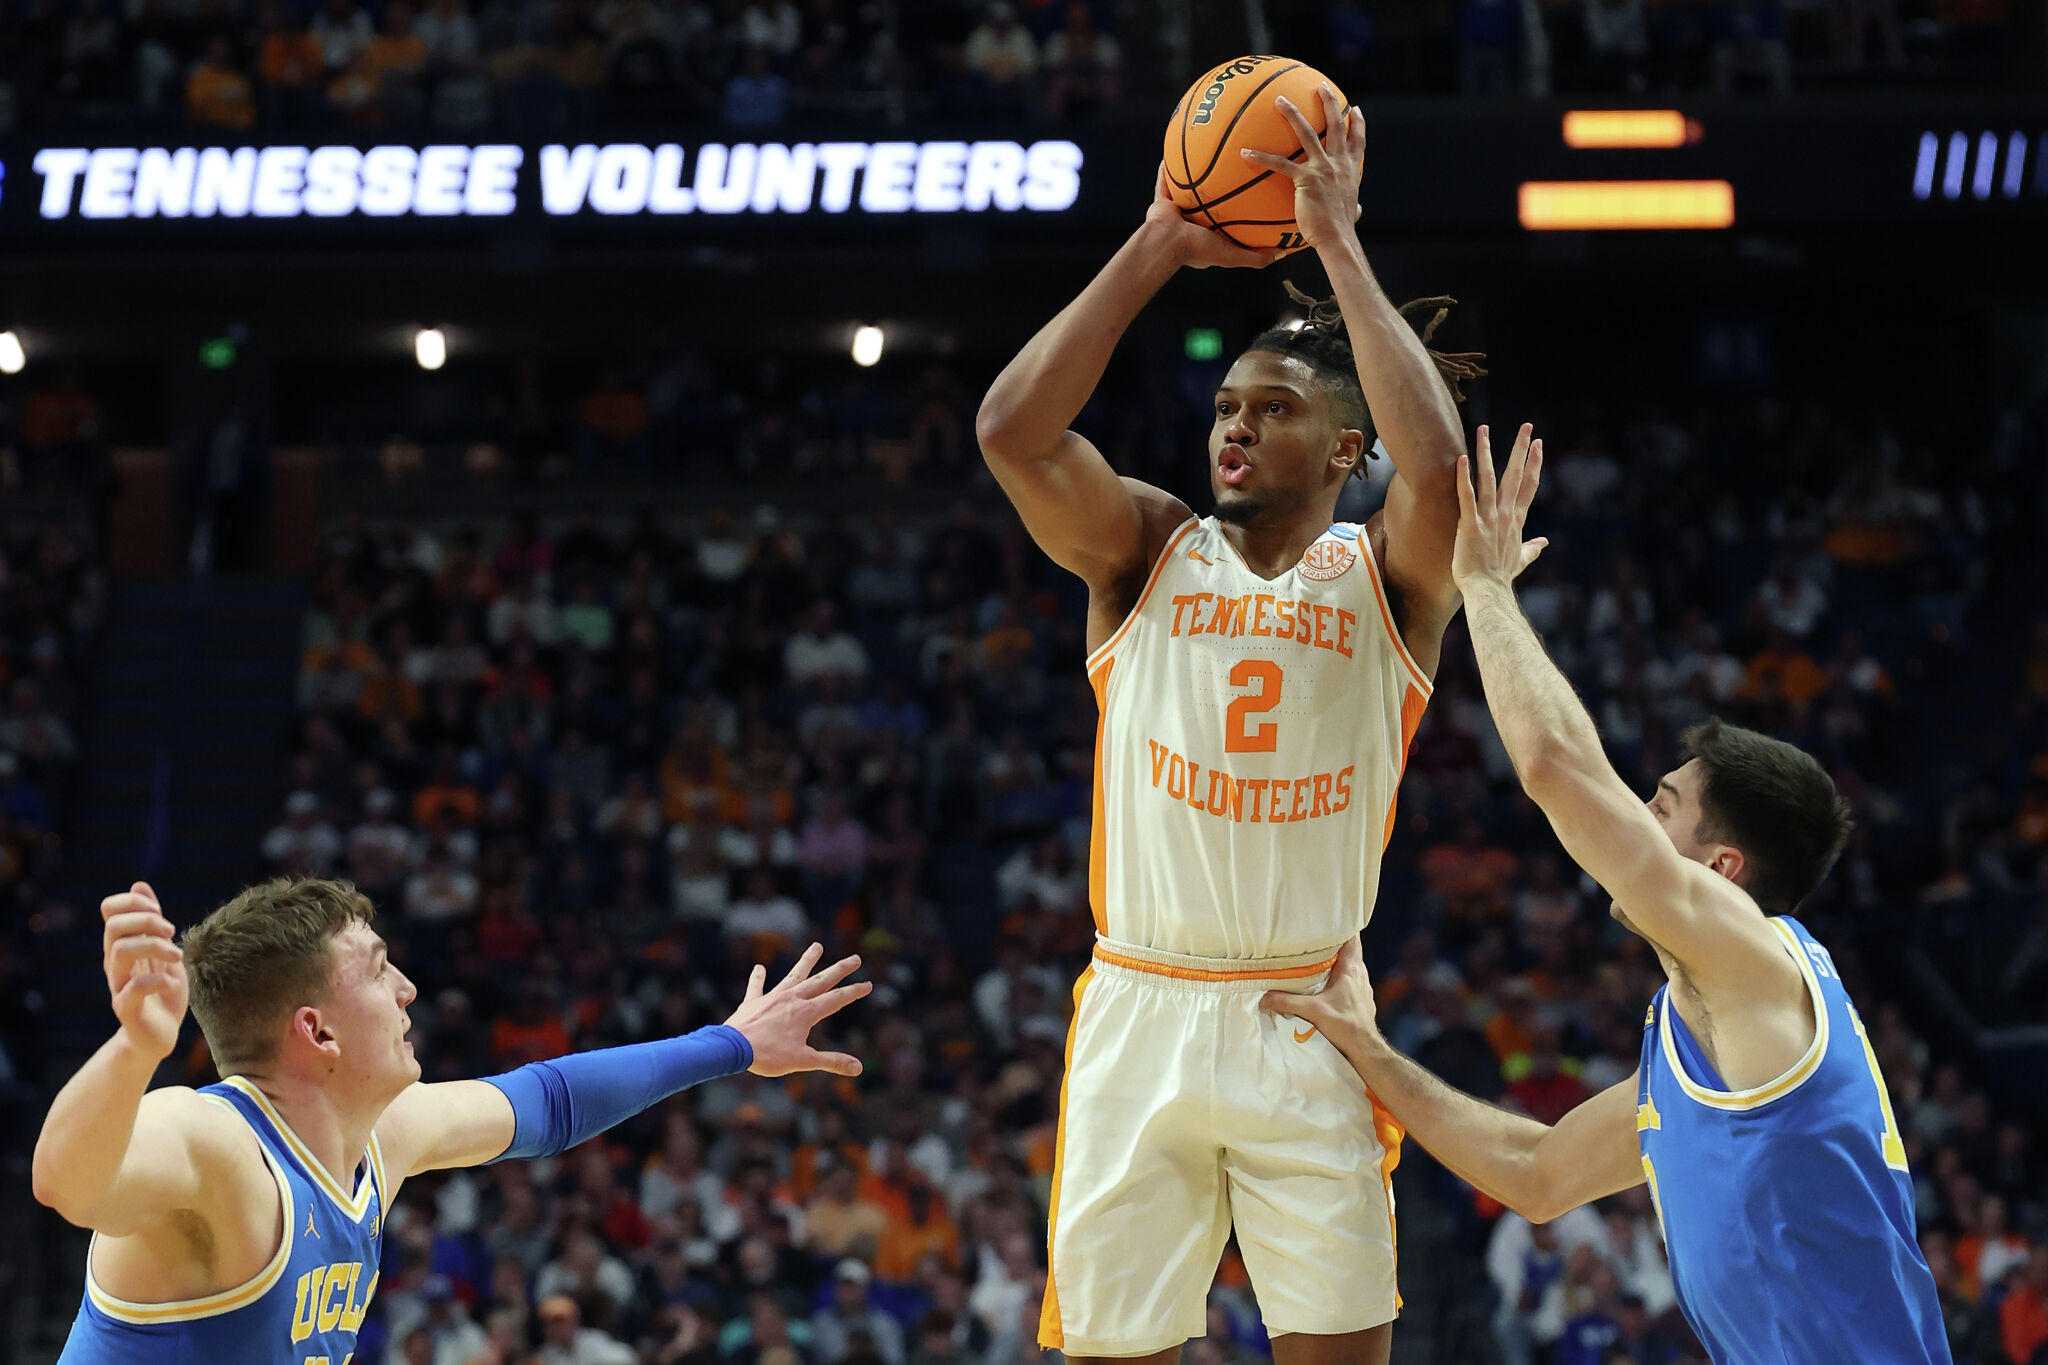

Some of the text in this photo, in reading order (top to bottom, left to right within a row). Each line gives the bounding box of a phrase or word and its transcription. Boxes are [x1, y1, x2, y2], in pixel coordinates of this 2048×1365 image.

[32, 145, 524, 219] TENNESSEE
[538, 140, 1084, 214] VOLUNTEERS
[1303, 562, 1349, 579] GRADUATE
[1306, 542, 1345, 568] SEC
[1170, 592, 1356, 659] TENNESSEE
[1225, 659, 1283, 753] 2
[1149, 738, 1354, 823] VOLUNTEERS
